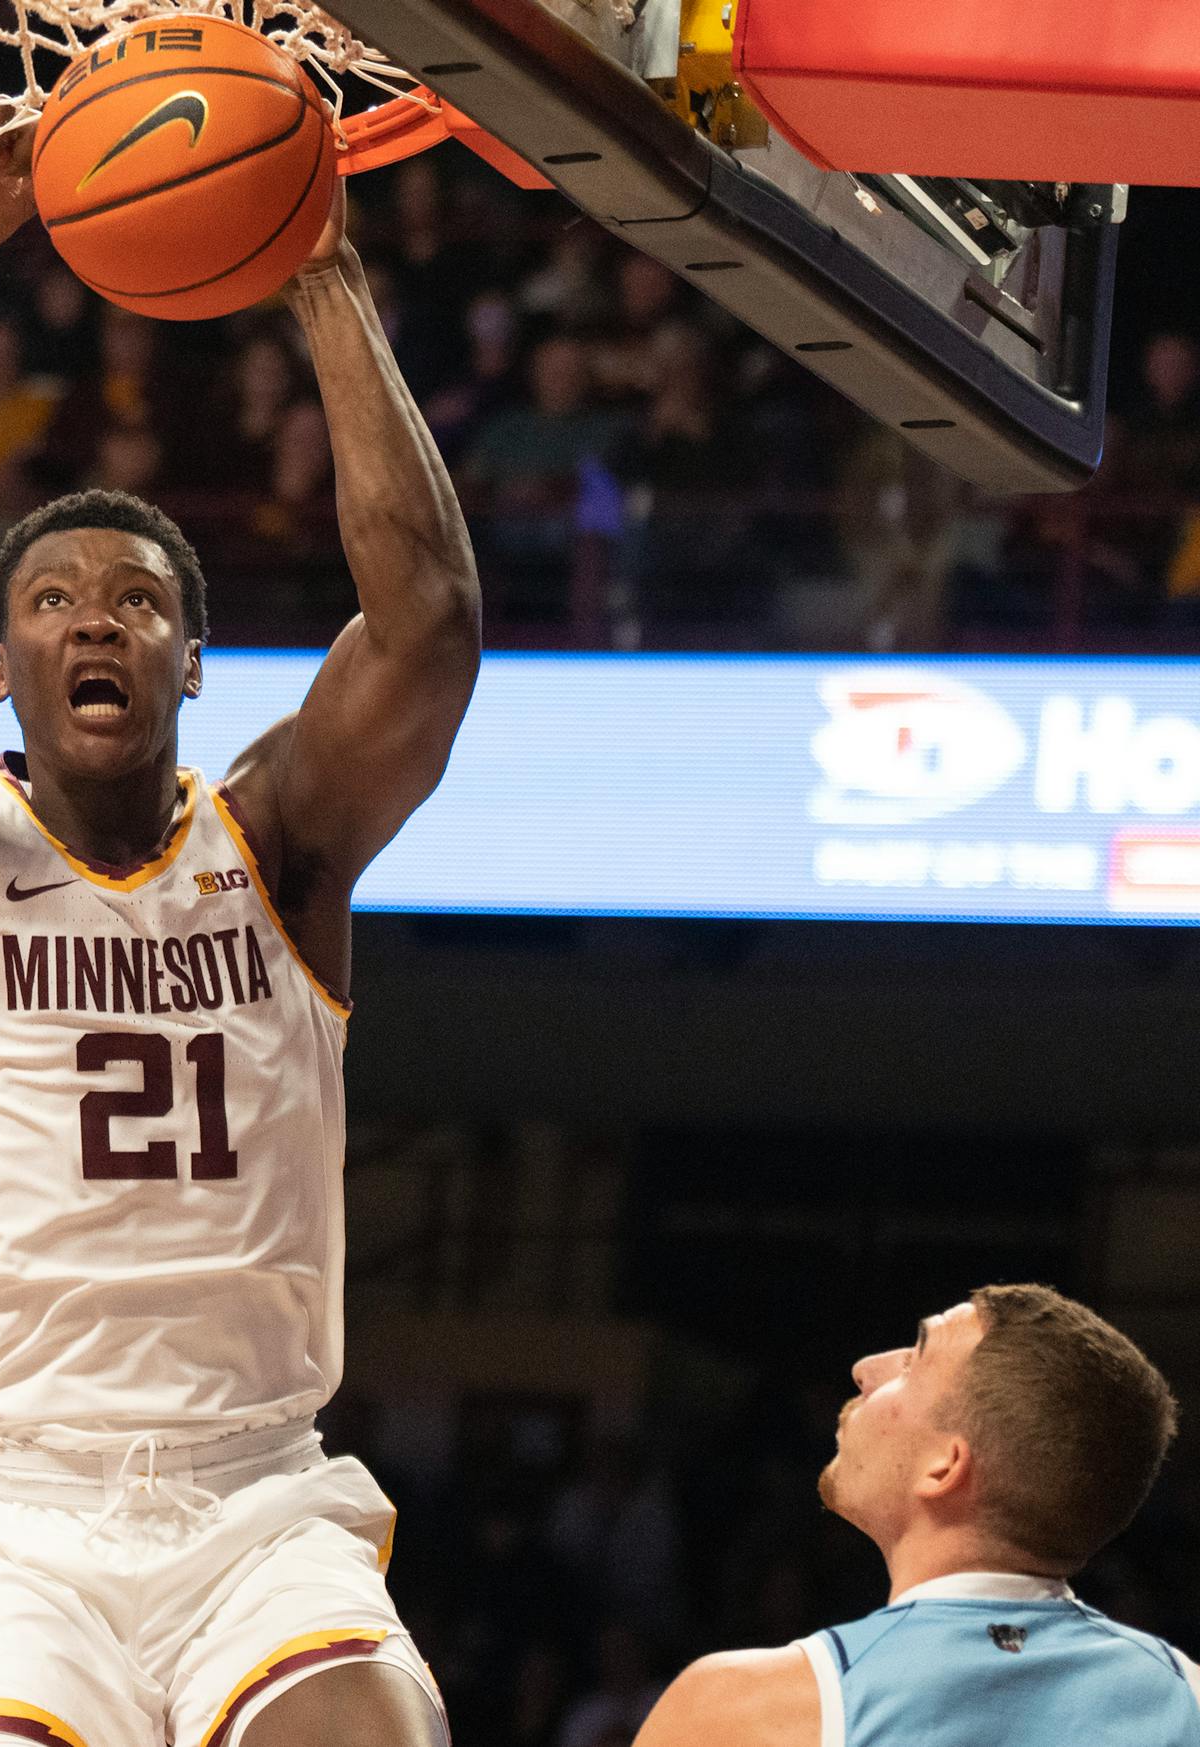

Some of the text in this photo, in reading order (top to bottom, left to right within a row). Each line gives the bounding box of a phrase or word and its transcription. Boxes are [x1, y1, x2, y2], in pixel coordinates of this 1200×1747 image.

[59, 28, 202, 101] ELITE
[2, 925, 272, 1014] MINNESOTA
[76, 1033, 238, 1180] 21
